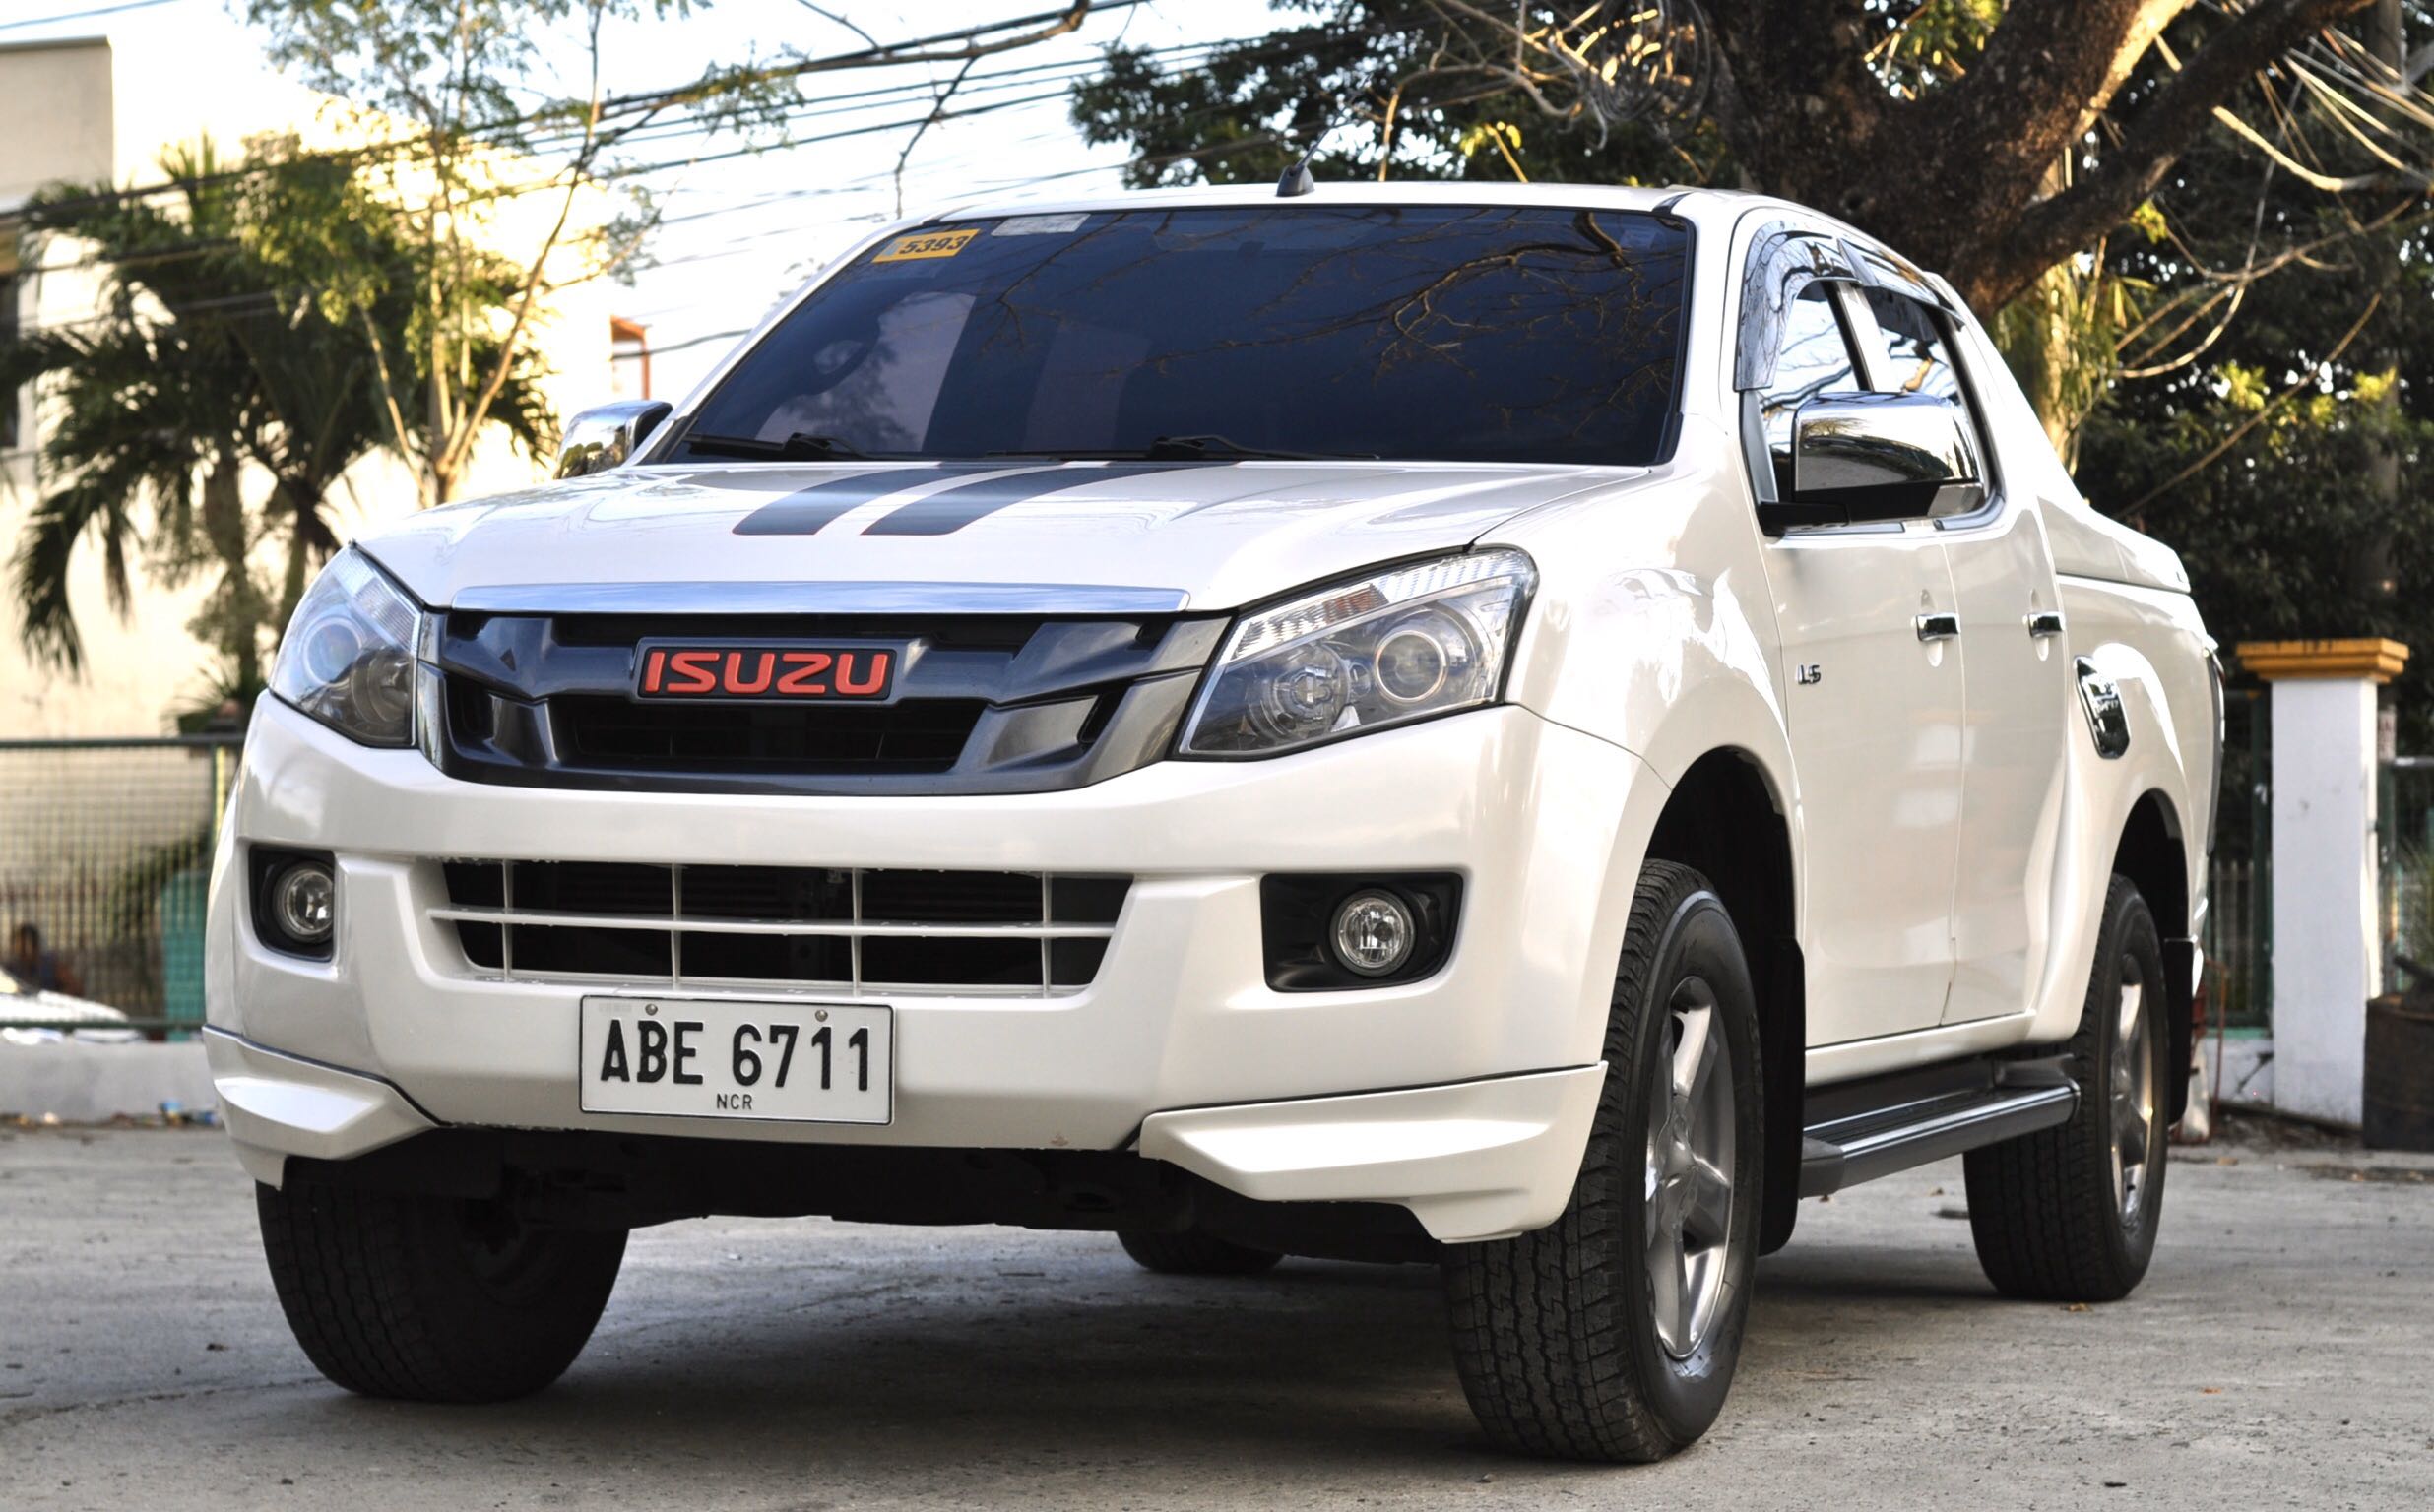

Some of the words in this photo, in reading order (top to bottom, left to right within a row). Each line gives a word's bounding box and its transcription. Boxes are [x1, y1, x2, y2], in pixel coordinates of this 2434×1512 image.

[899, 236, 968, 255] 5393
[645, 652, 888, 694] ISUZU
[601, 1019, 704, 1084] ABE
[733, 1024, 868, 1091] 6711
[716, 1093, 753, 1109] NCR
